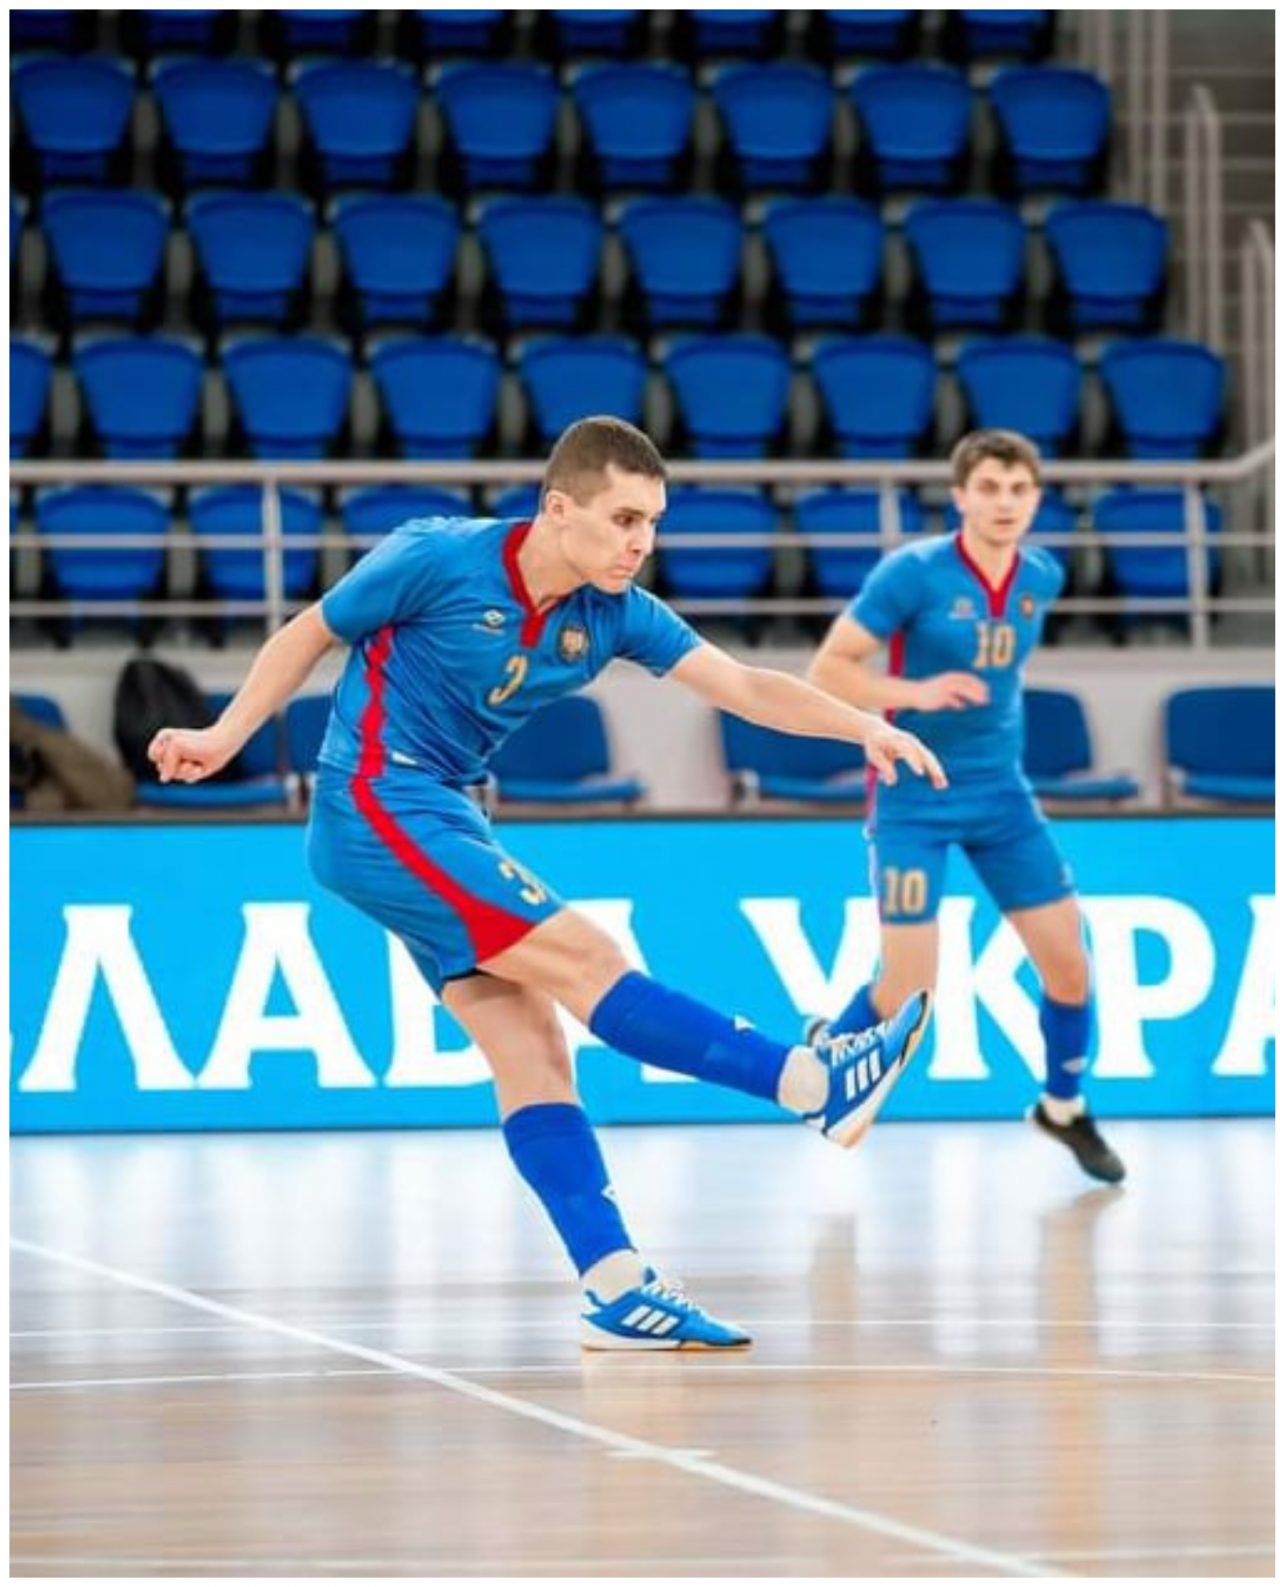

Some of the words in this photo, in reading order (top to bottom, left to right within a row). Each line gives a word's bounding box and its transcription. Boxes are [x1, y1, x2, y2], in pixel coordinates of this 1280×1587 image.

[973, 621, 1015, 669] 10
[489, 655, 527, 705] 3
[499, 858, 547, 906] 3
[884, 867, 927, 914] 10
